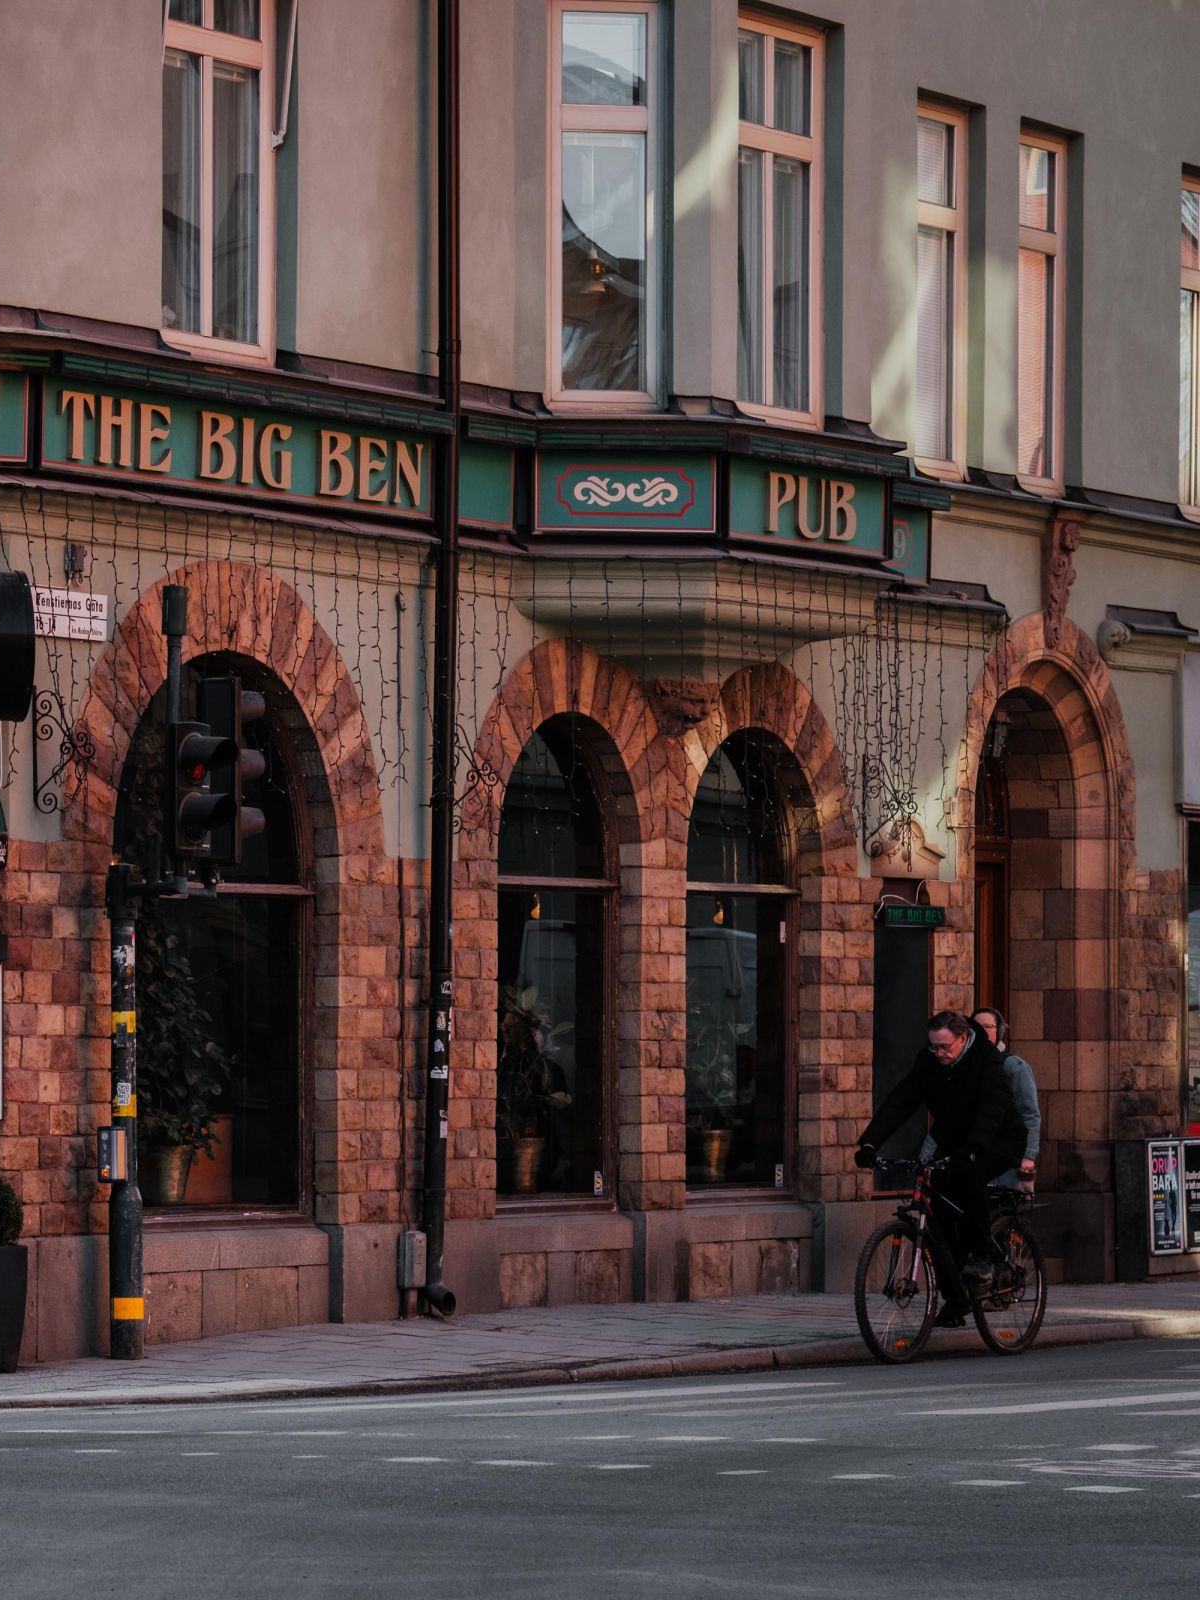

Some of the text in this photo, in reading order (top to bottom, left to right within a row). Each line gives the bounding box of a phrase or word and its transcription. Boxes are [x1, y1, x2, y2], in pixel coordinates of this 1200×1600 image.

[60, 390, 424, 507] THE BIG BEN
[765, 471, 858, 542] PUB
[86, 599, 104, 613] Gata
[887, 909, 904, 922] THE
[907, 909, 922, 923] BIG
[1152, 1157, 1178, 1174] ORUP
[1152, 1173, 1178, 1191] BARA
